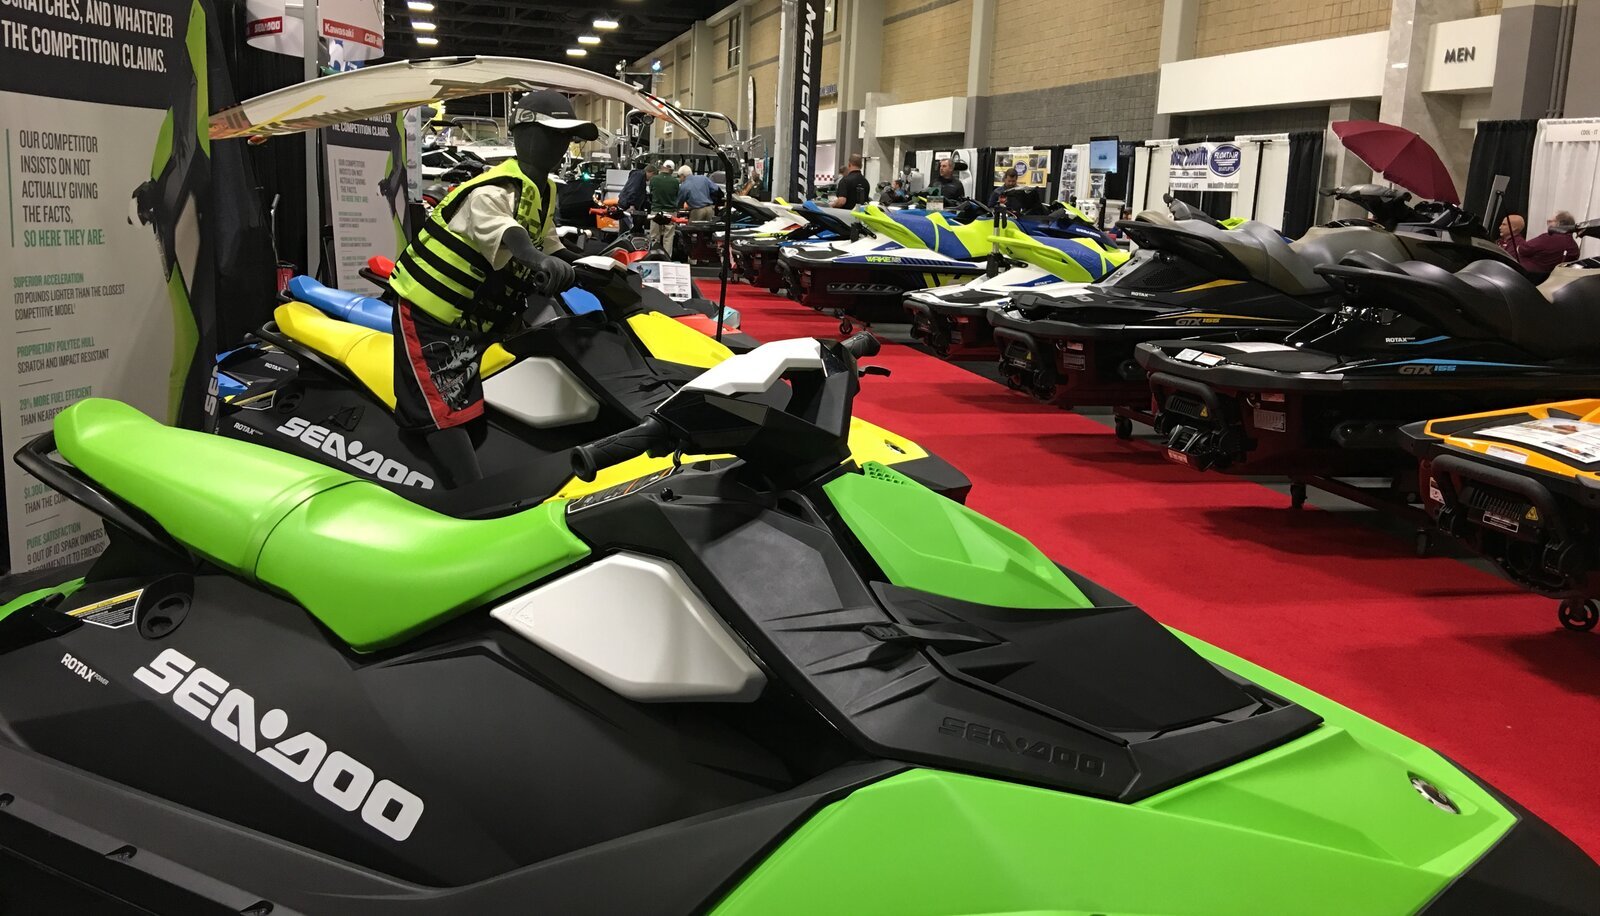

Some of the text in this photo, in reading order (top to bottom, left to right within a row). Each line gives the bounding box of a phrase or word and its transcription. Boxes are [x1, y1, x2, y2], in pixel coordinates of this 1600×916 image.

[2, 0, 174, 38] TCHES, AND WHATEVER
[324, 23, 354, 38] Kawasaki
[1, 20, 167, 73] THE COMPETITION CLAIMS.
[1444, 46, 1476, 64] MEN
[19, 130, 98, 153] OUR COMPETITOR
[21, 155, 91, 176] INSISTS ON NOT
[22, 180, 98, 199] ACTUALLY GIVING
[22, 205, 73, 224] THE FACTS,
[24, 229, 105, 248] SO HERE THEY ARE:
[13, 272, 84, 289] SUPERIOR ACCELERATION
[14, 283, 125, 304] 170 POUNDS LIGHTER THAN THE CLOSEST
[15, 305, 54, 321] COMPETITIVE
[1176, 318, 1202, 326] GTX
[16, 336, 95, 358] PROPRIETARY POLYTEC HULL
[17, 348, 110, 374] SCRATCH AND IMPACT RESISTANT
[264, 362, 281, 372] ROTAX
[1399, 365, 1434, 375] GTX
[33, 393, 49, 407] MORE
[51, 391, 64, 404] FUEL
[65, 385, 92, 400] EFFICIENT
[20, 412, 36, 426] THAN
[233, 422, 255, 435] ROTAX
[25, 502, 40, 514] THAN
[41, 498, 53, 509] THE
[26, 521, 81, 550] PURE SATISFACTION
[27, 554, 31, 565] 9
[33, 550, 44, 563] OUT
[45, 547, 53, 559] OF
[61, 540, 79, 552] SPARK
[80, 528, 103, 543] OWNERS
[73, 551, 80, 562] TO
[61, 652, 96, 682] ROTAX
